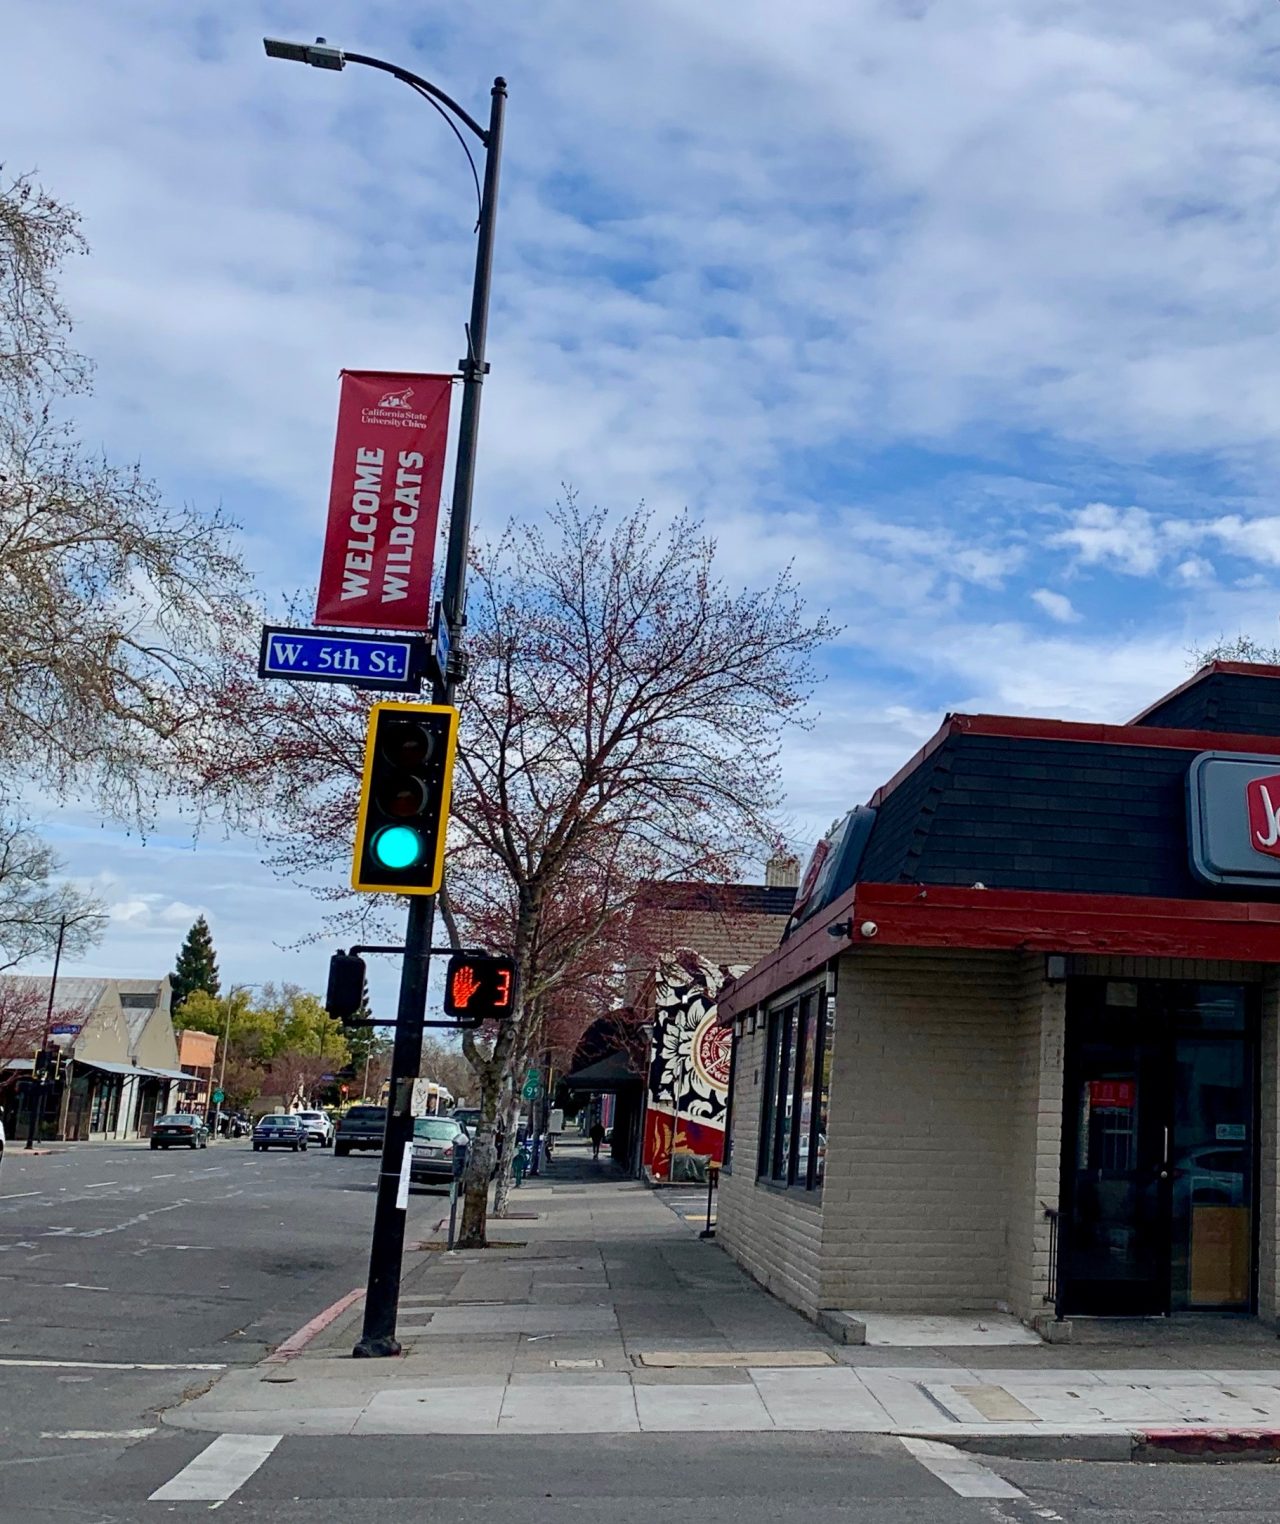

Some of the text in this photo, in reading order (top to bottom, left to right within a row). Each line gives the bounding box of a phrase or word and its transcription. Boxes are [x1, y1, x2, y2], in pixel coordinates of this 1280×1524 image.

[361, 408, 428, 420] California State
[401, 419, 427, 429] Chico
[340, 447, 385, 601] WELCOME
[381, 450, 424, 604] WILDCATS
[272, 642, 404, 674] W. 5th St.
[493, 969, 511, 1007] 3
